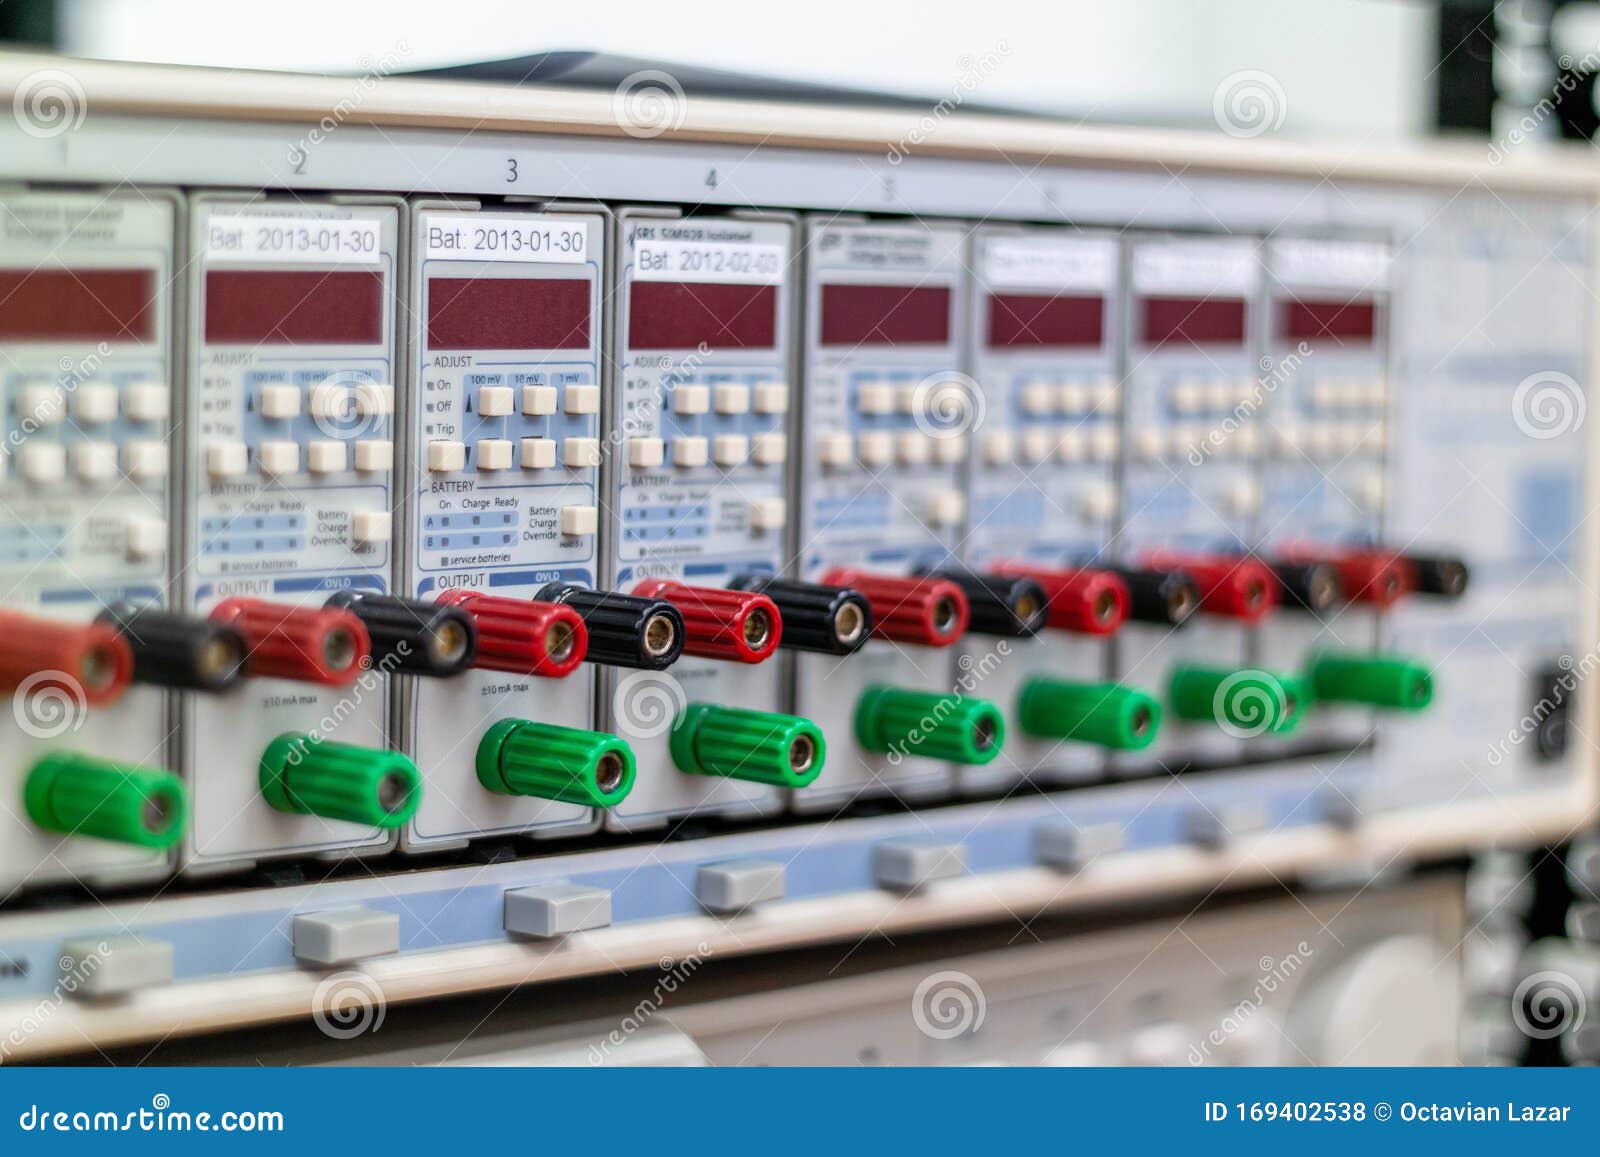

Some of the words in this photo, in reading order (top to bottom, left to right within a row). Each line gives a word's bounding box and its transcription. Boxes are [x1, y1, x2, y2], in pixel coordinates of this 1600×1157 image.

[506, 159, 519, 183] 3
[704, 169, 718, 189] 4
[258, 227, 375, 252] 2013-01-30
[429, 227, 467, 250] Bat:
[474, 228, 583, 253] 2013-01-30
[434, 356, 473, 368] ADJUST
[471, 375, 486, 384] 100
[487, 375, 501, 384] mV
[515, 375, 524, 383] 10
[525, 375, 540, 384] mV
[566, 374, 580, 382] mV
[437, 380, 452, 390] On
[437, 401, 453, 412] Off
[437, 423, 455, 436] Trip
[210, 483, 258, 496] BATTERY
[432, 480, 475, 494] BATTERY
[279, 501, 305, 512] Ready
[439, 500, 451, 510] On
[462, 499, 491, 510] Charge
[494, 497, 519, 509] Ready
[318, 511, 348, 521] Battery
[529, 506, 558, 517] Battery
[427, 518, 433, 527] A
[529, 518, 558, 529] Charge
[318, 523, 348, 534] Charge
[311, 536, 348, 547] Override
[523, 531, 558, 541] Override
[427, 538, 433, 547] B
[450, 556, 477, 566] service
[477, 554, 511, 564] batteries
[438, 574, 486, 589] OUTPUT
[535, 572, 561, 582] OVLD
[218, 580, 270, 595] OUTPUT
[481, 685, 497, 695] ±10
[498, 683, 511, 693] mA
[512, 684, 529, 692] max
